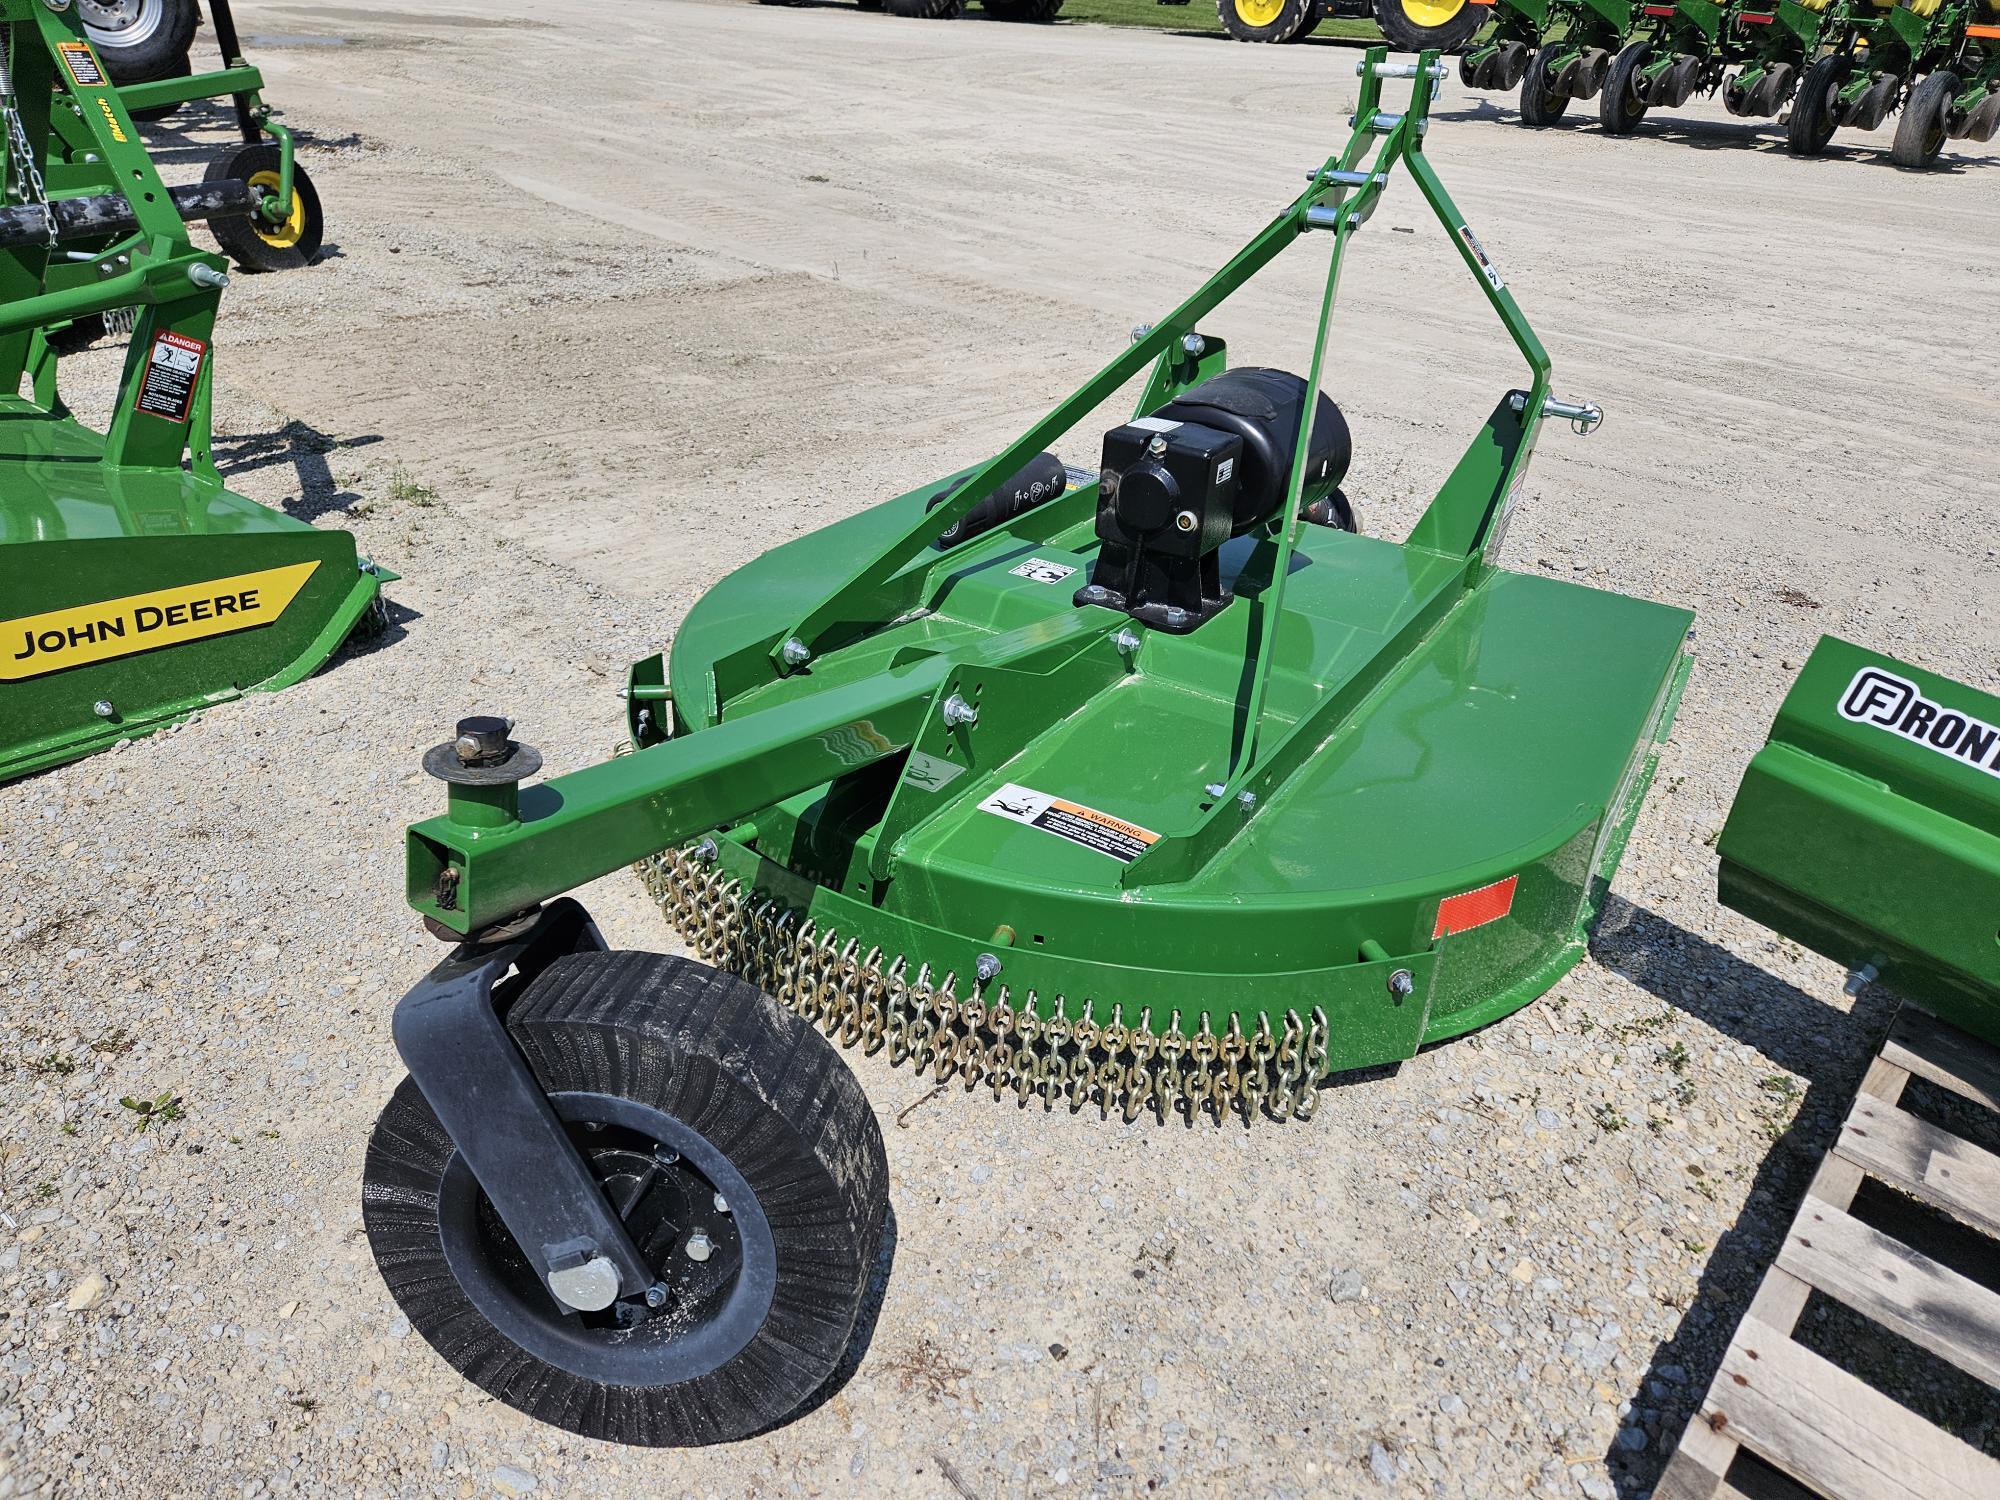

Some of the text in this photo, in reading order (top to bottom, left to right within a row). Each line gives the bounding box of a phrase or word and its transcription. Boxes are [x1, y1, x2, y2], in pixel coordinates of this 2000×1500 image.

[167, 334, 201, 351] DANGER
[15, 589, 261, 660] JOHN DEERE
[1844, 671, 2000, 772] FRON
[1090, 813, 1142, 837] WARNING
